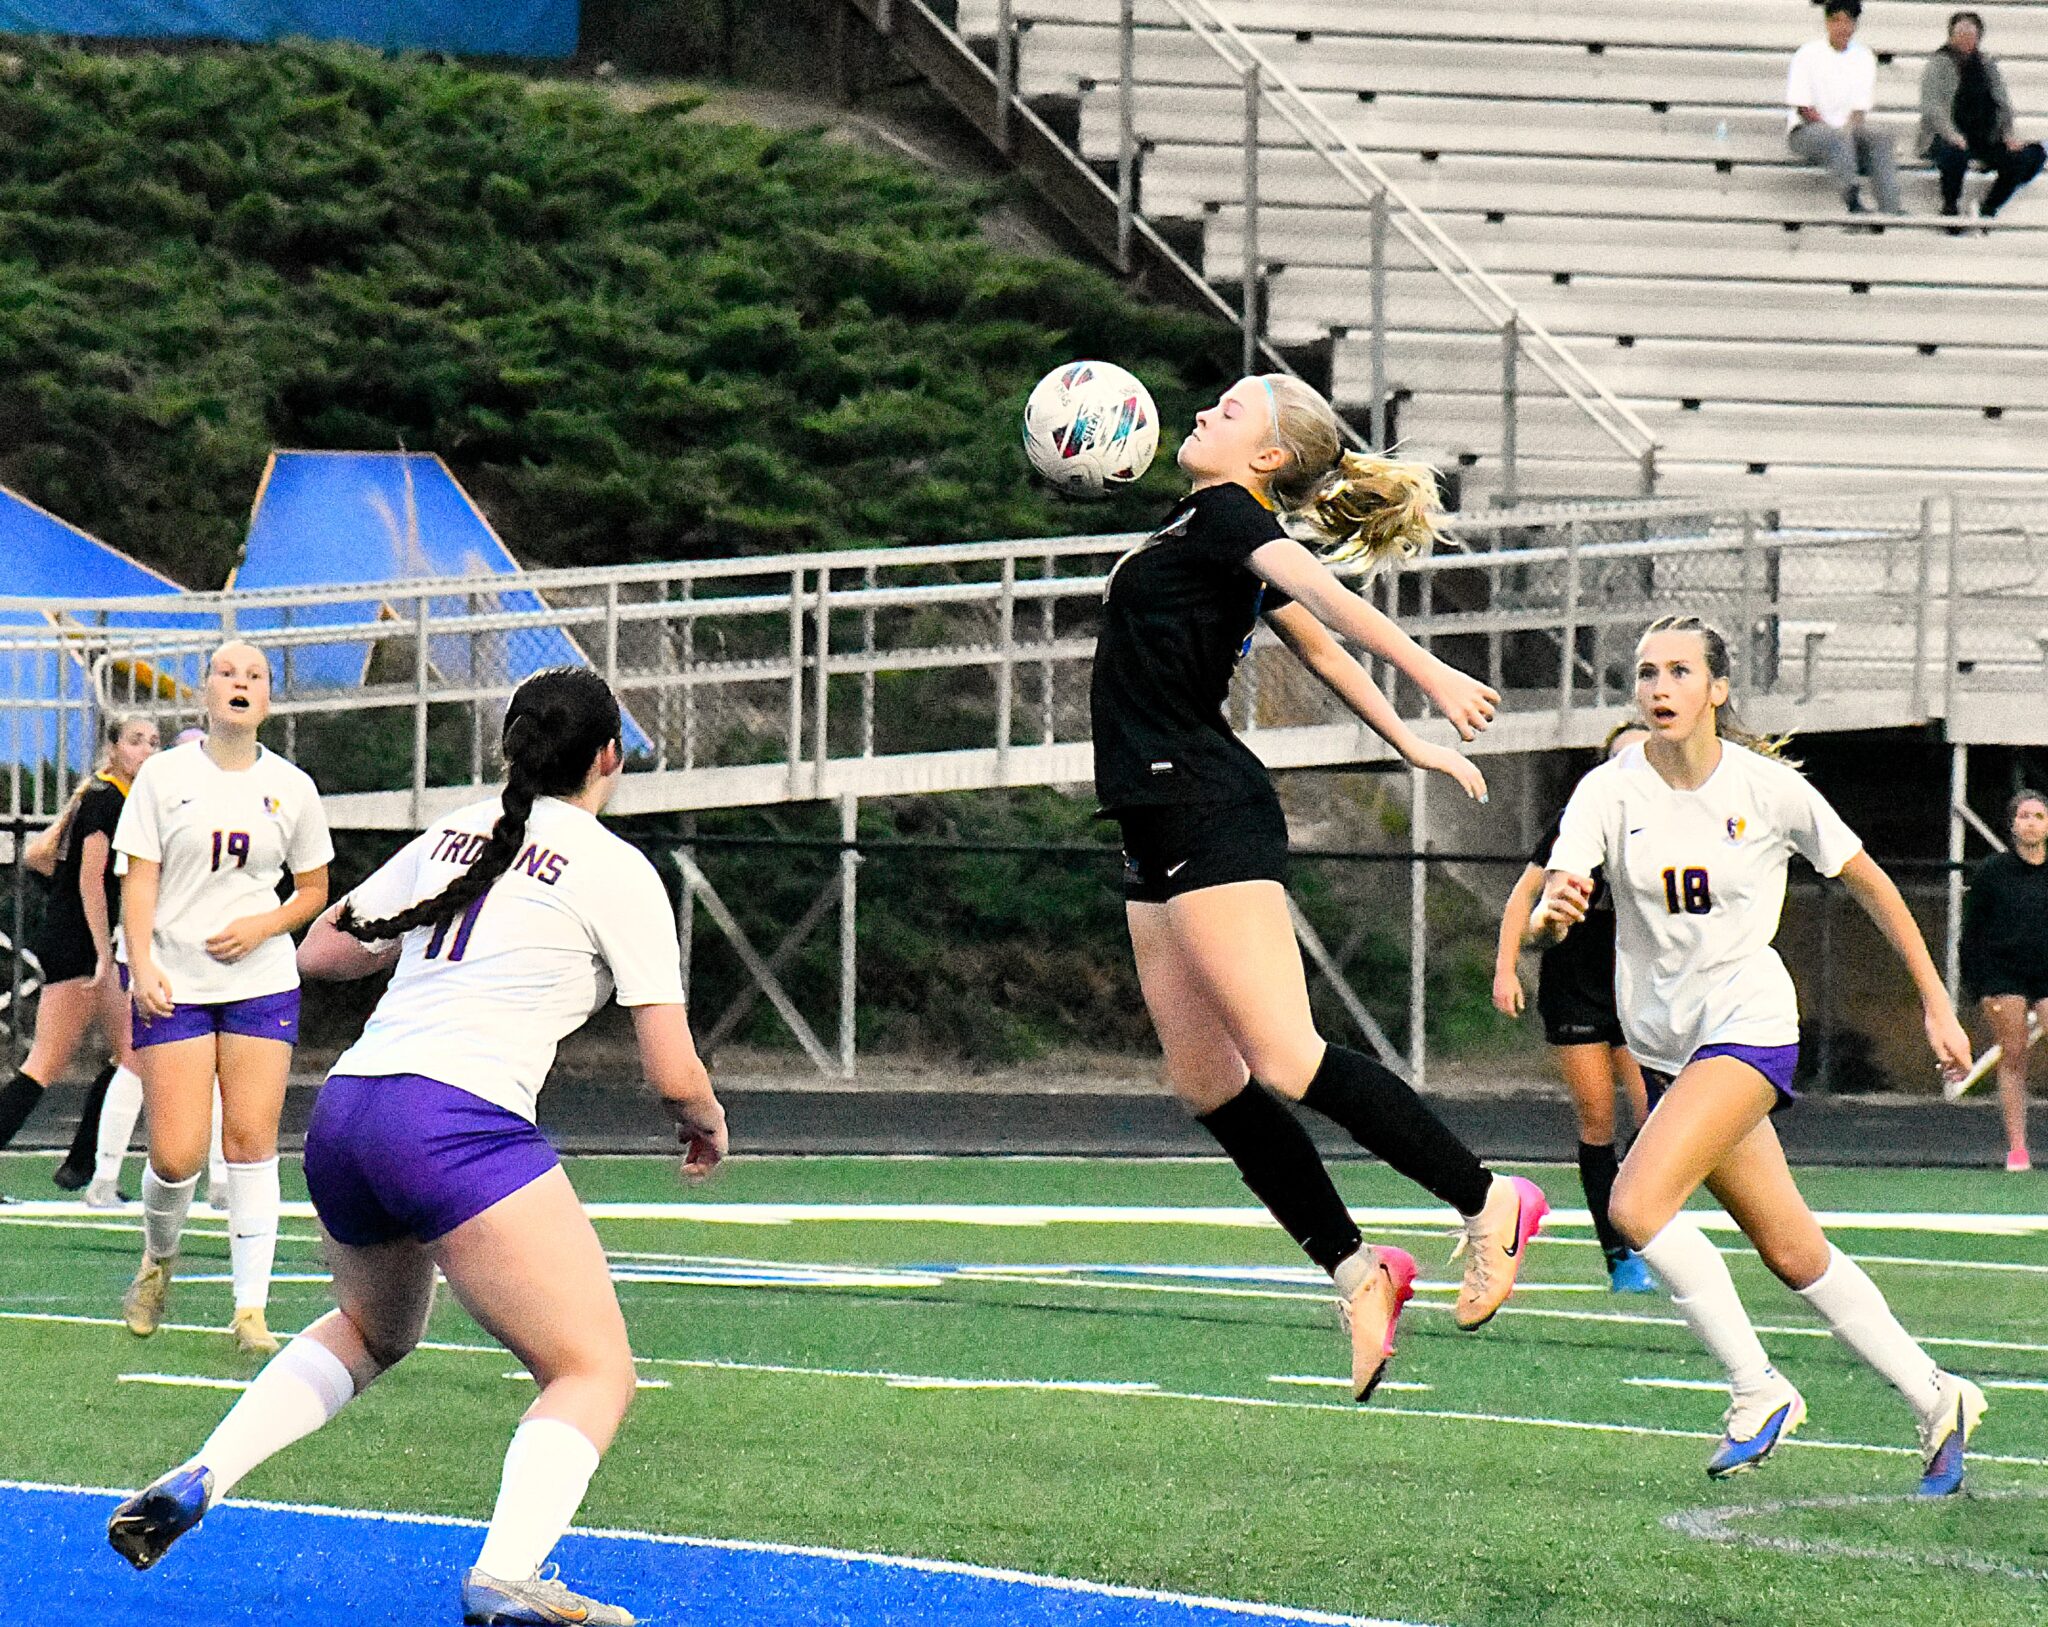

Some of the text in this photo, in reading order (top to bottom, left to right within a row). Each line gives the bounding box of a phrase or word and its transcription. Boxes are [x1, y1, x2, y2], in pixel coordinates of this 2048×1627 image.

[211, 829, 250, 872] 19
[430, 829, 569, 886] TRONS
[1662, 866, 1713, 915] 18
